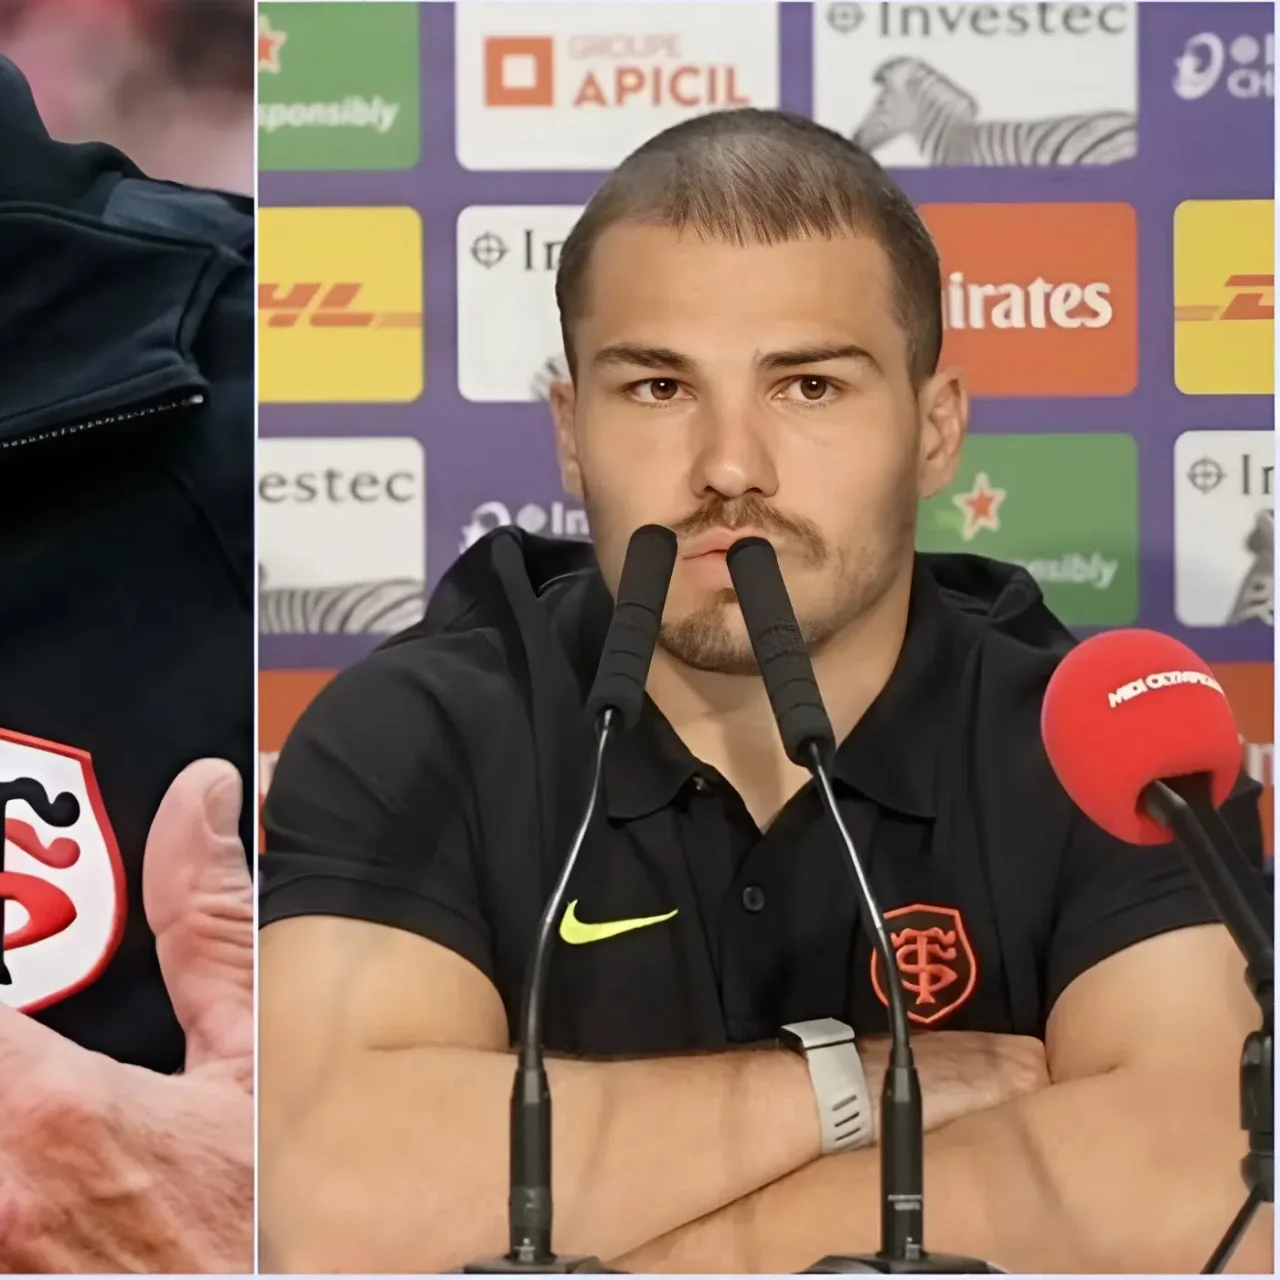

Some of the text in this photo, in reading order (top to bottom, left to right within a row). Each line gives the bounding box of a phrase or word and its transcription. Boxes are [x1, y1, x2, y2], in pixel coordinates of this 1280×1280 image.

[878, 2, 1128, 37] Investec
[573, 65, 749, 107] APICIL
[942, 271, 1113, 329] irates
[258, 467, 416, 504] estec
